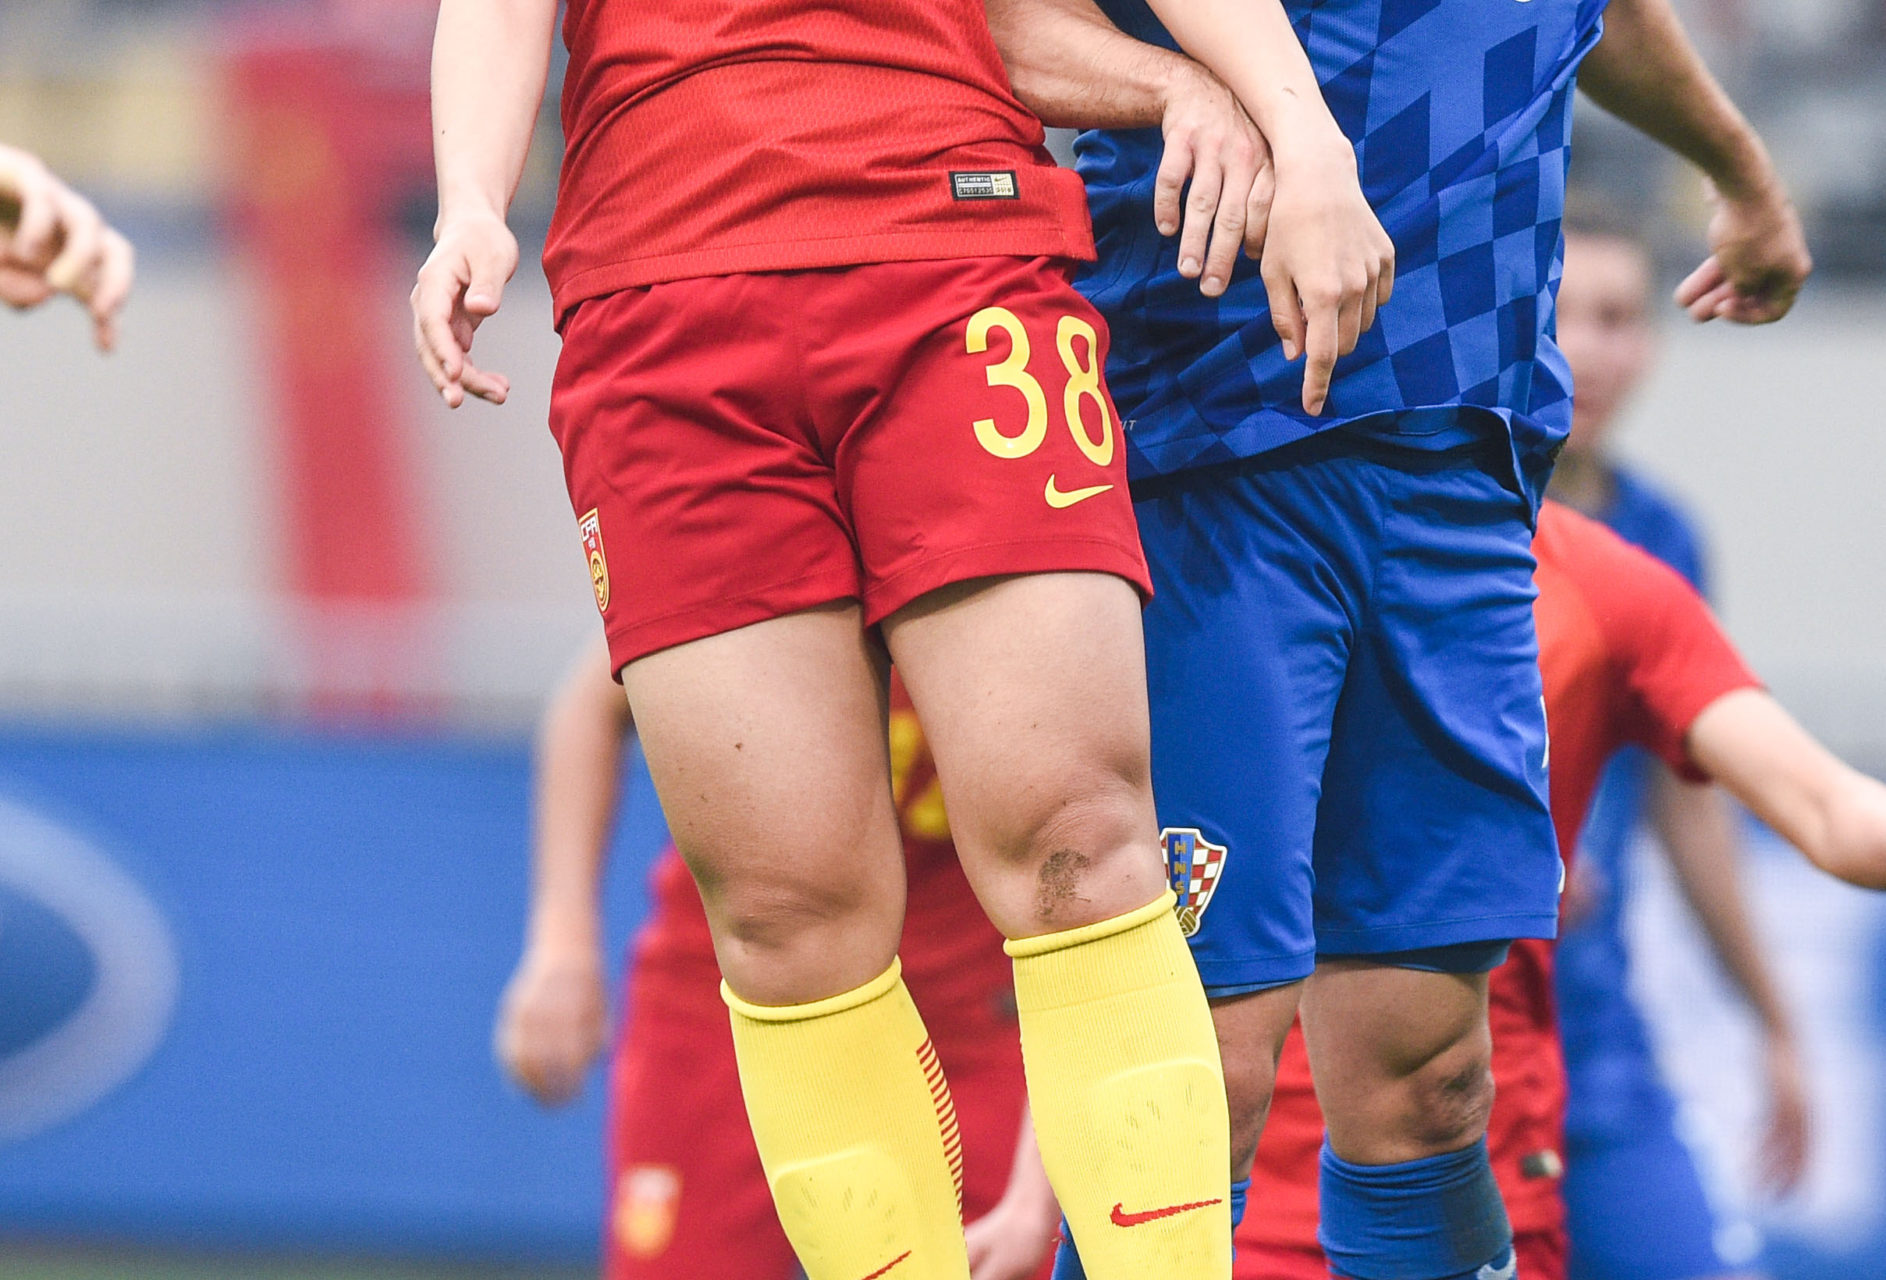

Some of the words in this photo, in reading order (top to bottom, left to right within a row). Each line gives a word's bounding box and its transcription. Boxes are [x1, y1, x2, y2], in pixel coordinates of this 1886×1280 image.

[966, 306, 1114, 466] 38
[1120, 419, 1137, 431] IT
[580, 516, 598, 542] CFA
[1173, 840, 1188, 896] HNS
